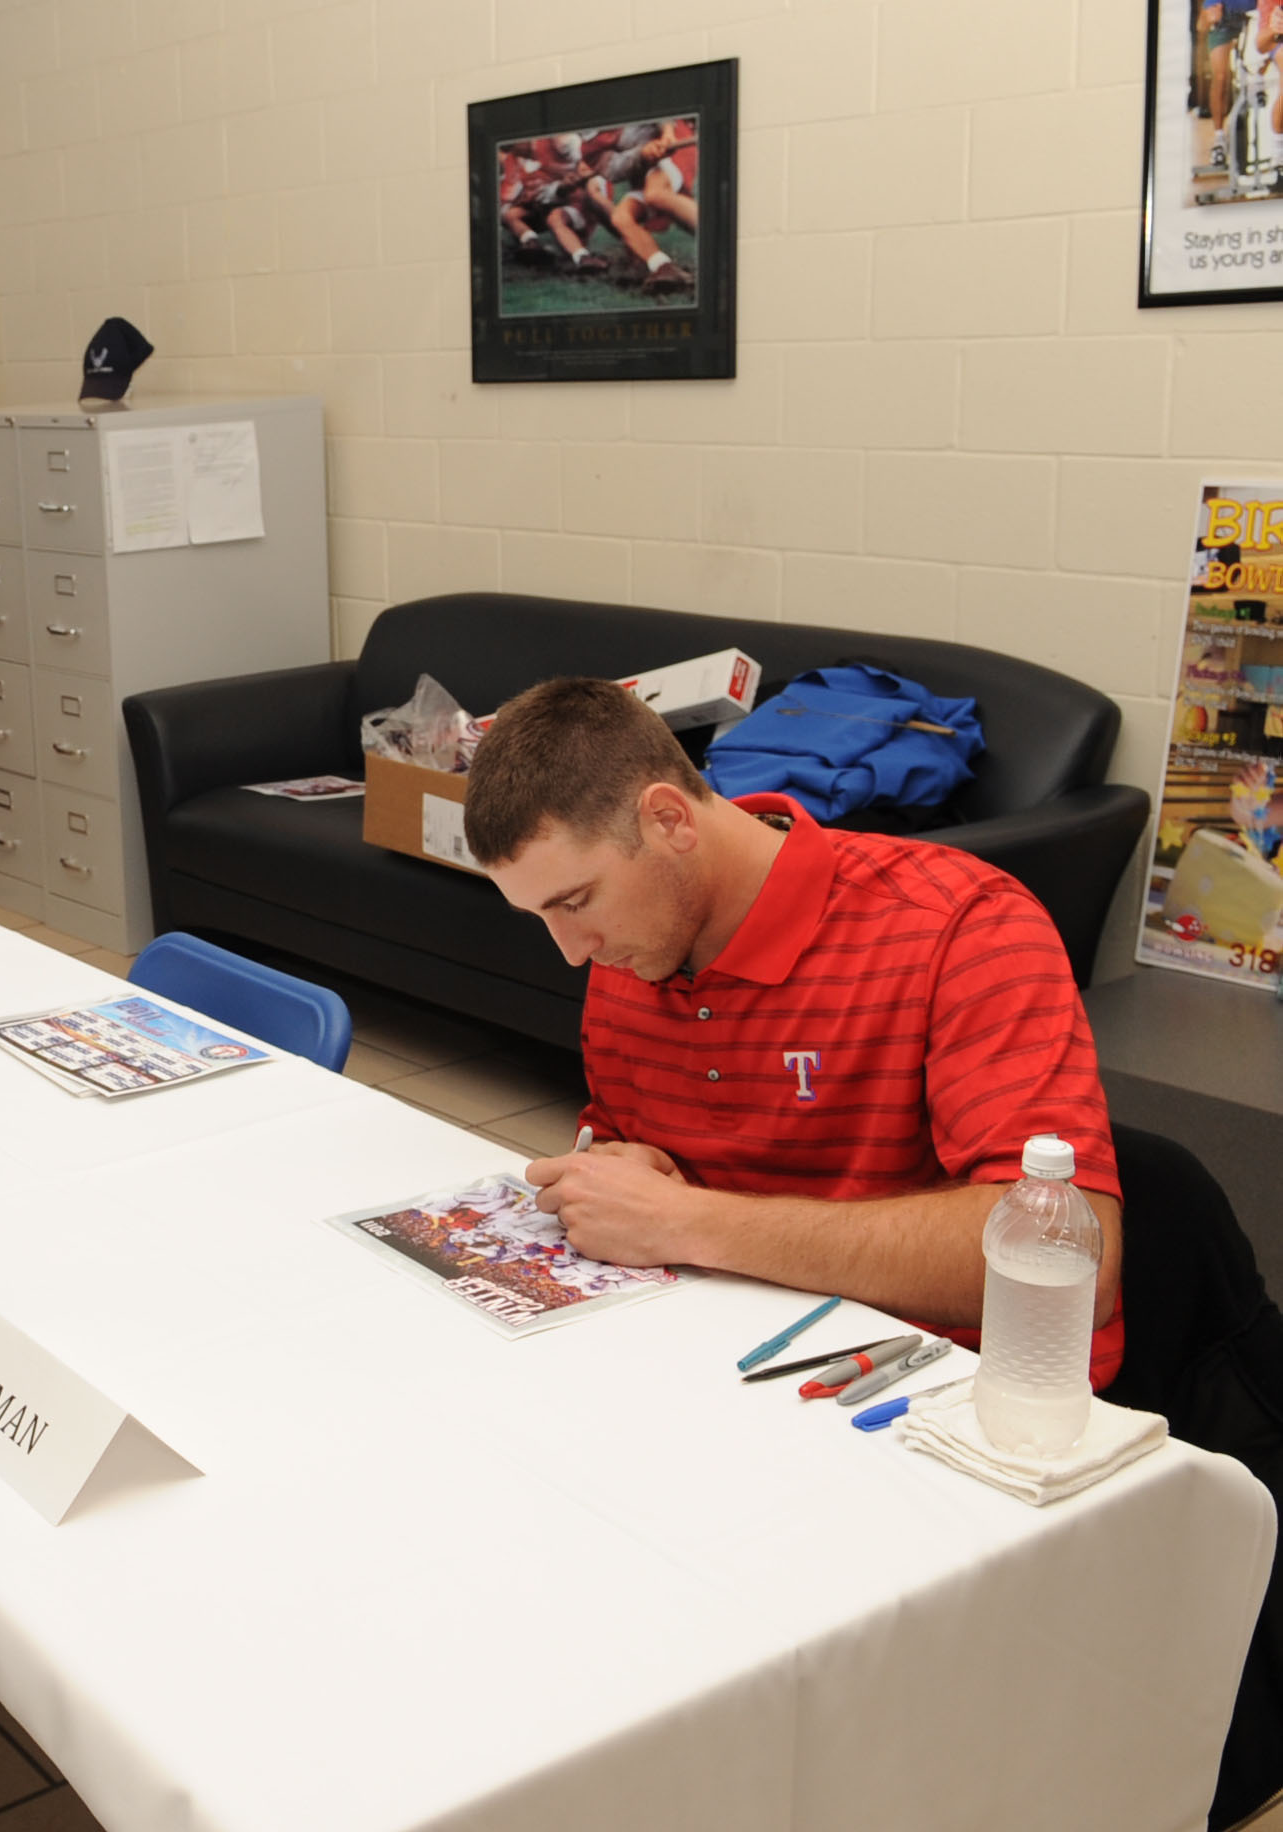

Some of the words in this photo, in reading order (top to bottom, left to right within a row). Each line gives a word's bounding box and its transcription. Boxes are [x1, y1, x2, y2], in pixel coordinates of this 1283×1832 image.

[1184, 229, 1243, 252] Staying
[1247, 227, 1263, 244] in
[1189, 256, 1207, 269] us
[1212, 251, 1264, 272] young
[1229, 942, 1275, 974] 318
[783, 1050, 821, 1102] T
[359, 1220, 392, 1238] 2011
[443, 1276, 538, 1327] WINTER
